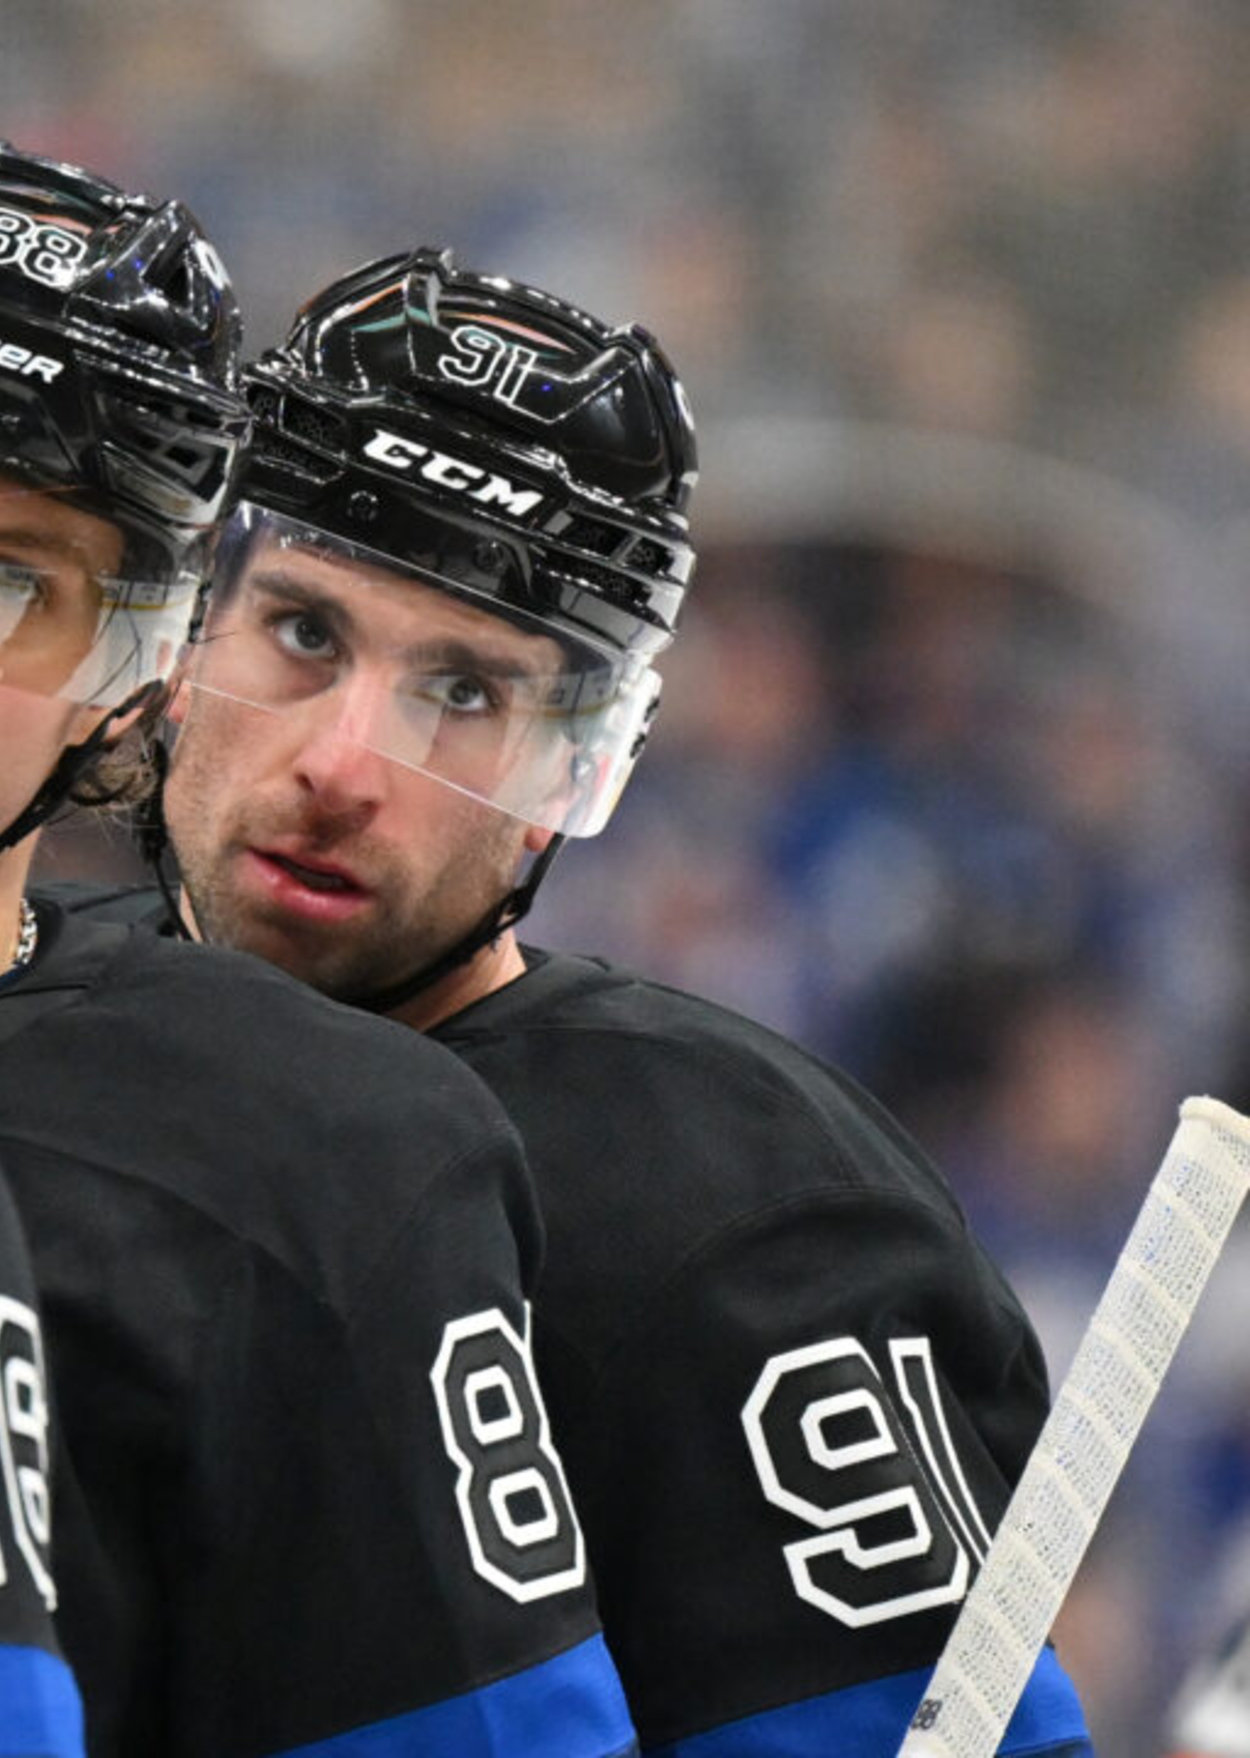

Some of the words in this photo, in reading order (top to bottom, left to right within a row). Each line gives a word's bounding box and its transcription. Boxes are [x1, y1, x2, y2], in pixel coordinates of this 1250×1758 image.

[437, 324, 538, 406] 91
[363, 429, 545, 517] CCM
[429, 1299, 586, 1604] 8
[740, 1336, 993, 1629] 91
